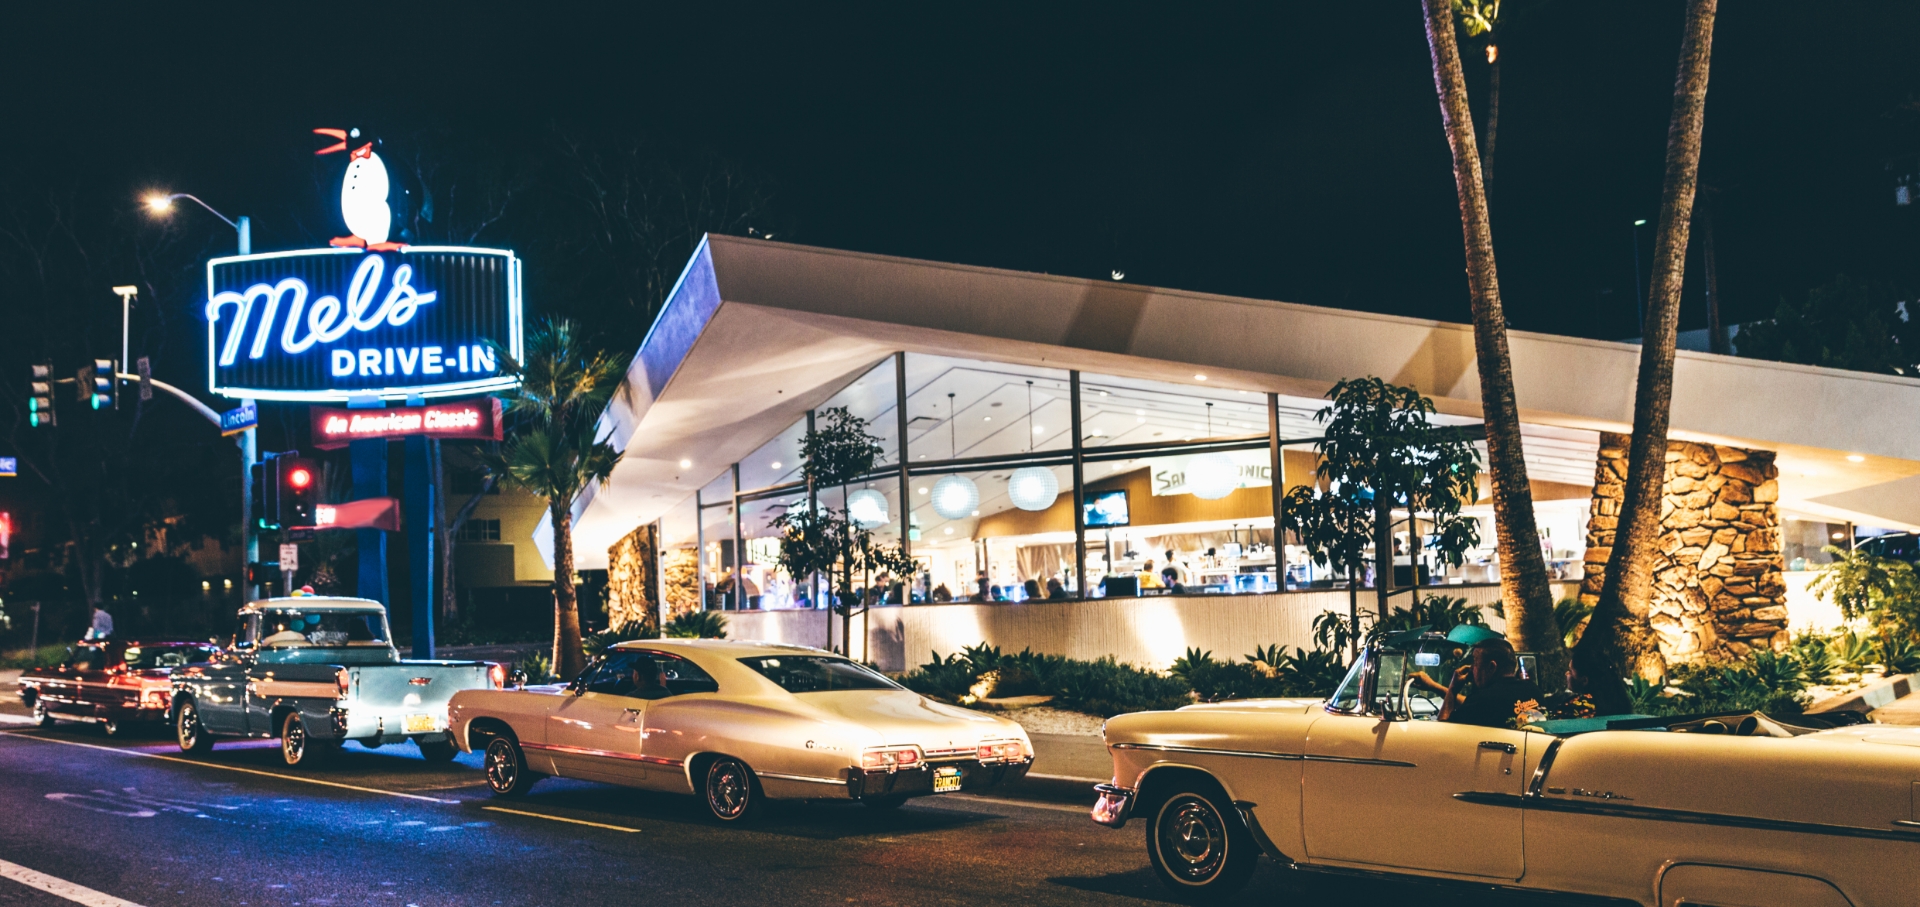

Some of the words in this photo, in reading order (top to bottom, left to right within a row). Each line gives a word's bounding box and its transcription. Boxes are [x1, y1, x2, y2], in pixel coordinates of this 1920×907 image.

[206, 254, 436, 366] Mels
[331, 345, 495, 376] DRIVE-IN
[223, 407, 255, 428] Lincoln
[325, 416, 348, 434] An
[349, 412, 422, 433] American
[424, 409, 478, 428] Classic
